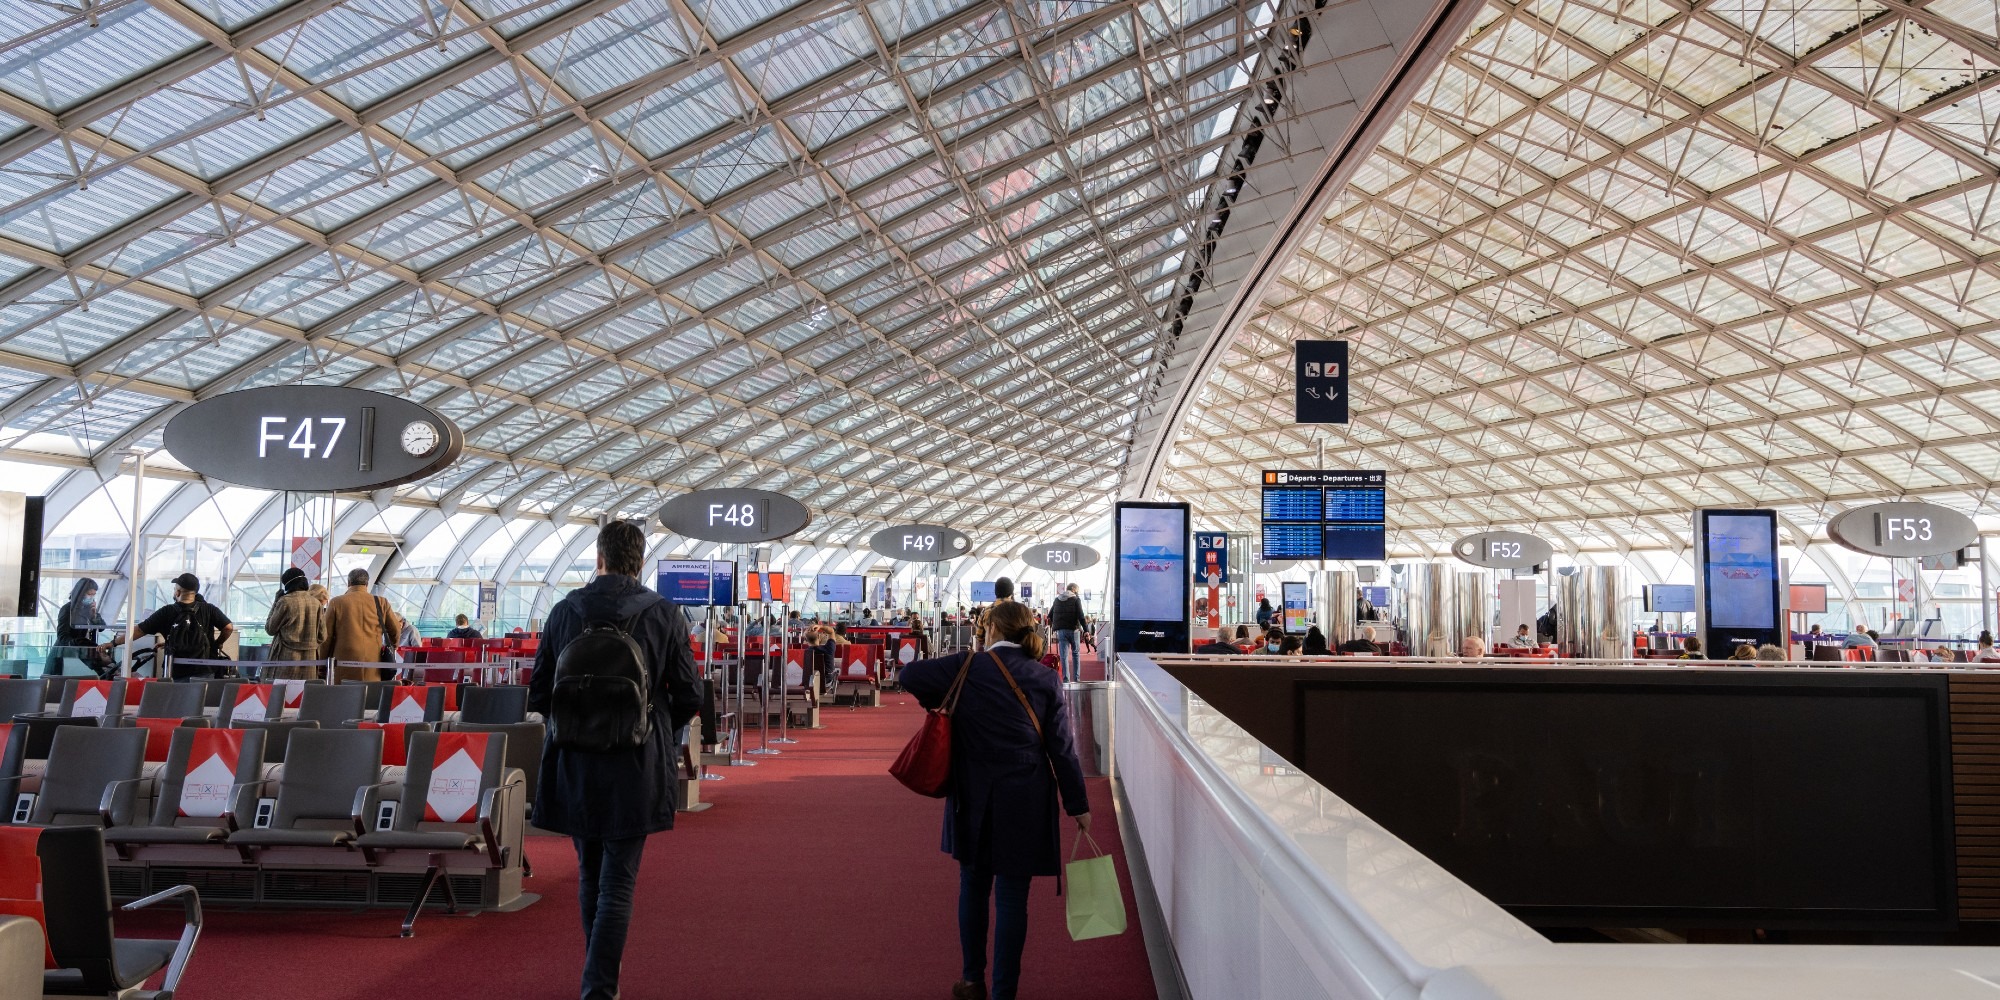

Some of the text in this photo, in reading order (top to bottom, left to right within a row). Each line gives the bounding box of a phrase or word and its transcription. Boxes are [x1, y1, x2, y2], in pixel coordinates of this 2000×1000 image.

[259, 416, 346, 459] F47
[1288, 475, 1317, 483] Départs
[1322, 475, 1363, 483] Departures
[709, 503, 755, 527] F48
[1887, 518, 1933, 541] F53
[903, 534, 936, 551] F49
[1490, 541, 1521, 559] F52
[1046, 550, 1071, 564] F50
